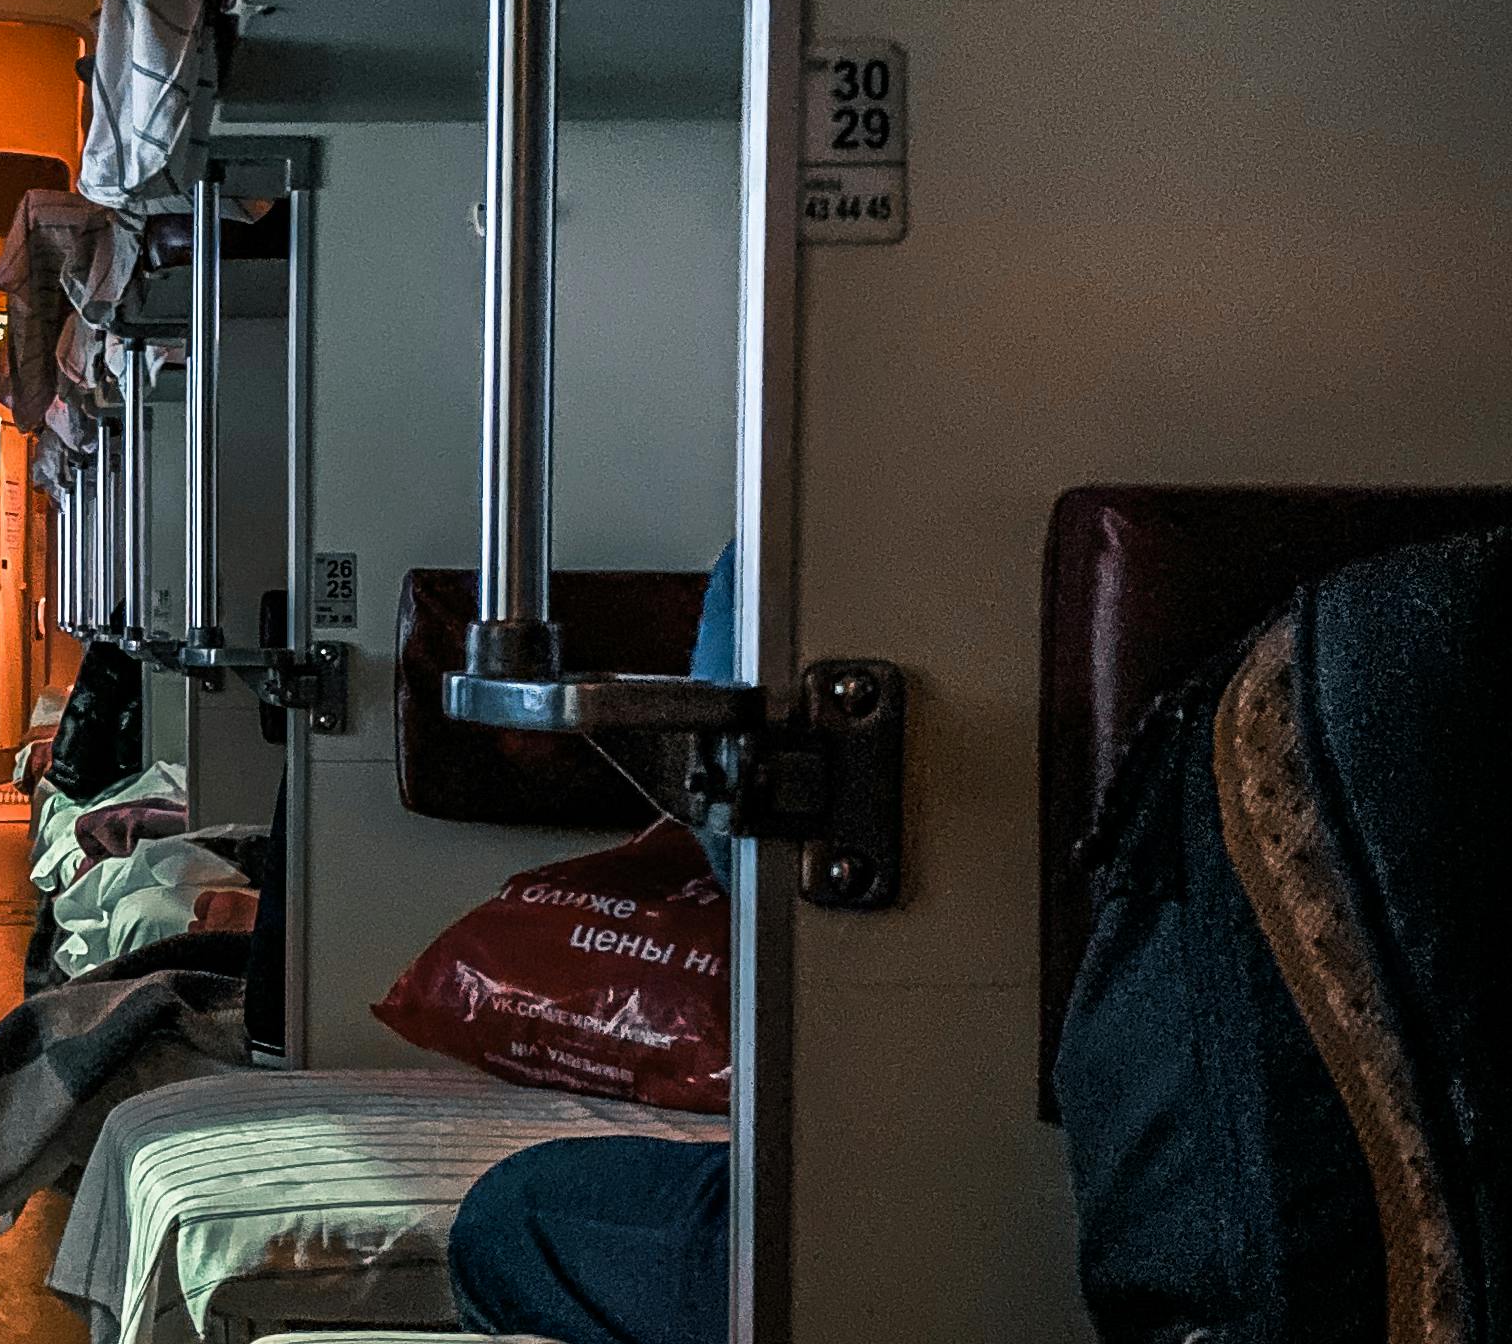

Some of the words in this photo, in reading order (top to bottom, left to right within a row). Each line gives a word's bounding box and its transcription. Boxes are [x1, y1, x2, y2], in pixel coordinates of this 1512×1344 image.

[832, 59, 889, 100] 30
[832, 108, 889, 149] 29
[327, 560, 353, 578] 26
[327, 580, 353, 599] 25
[521, 883, 638, 920] ближе
[569, 923, 677, 966] цены
